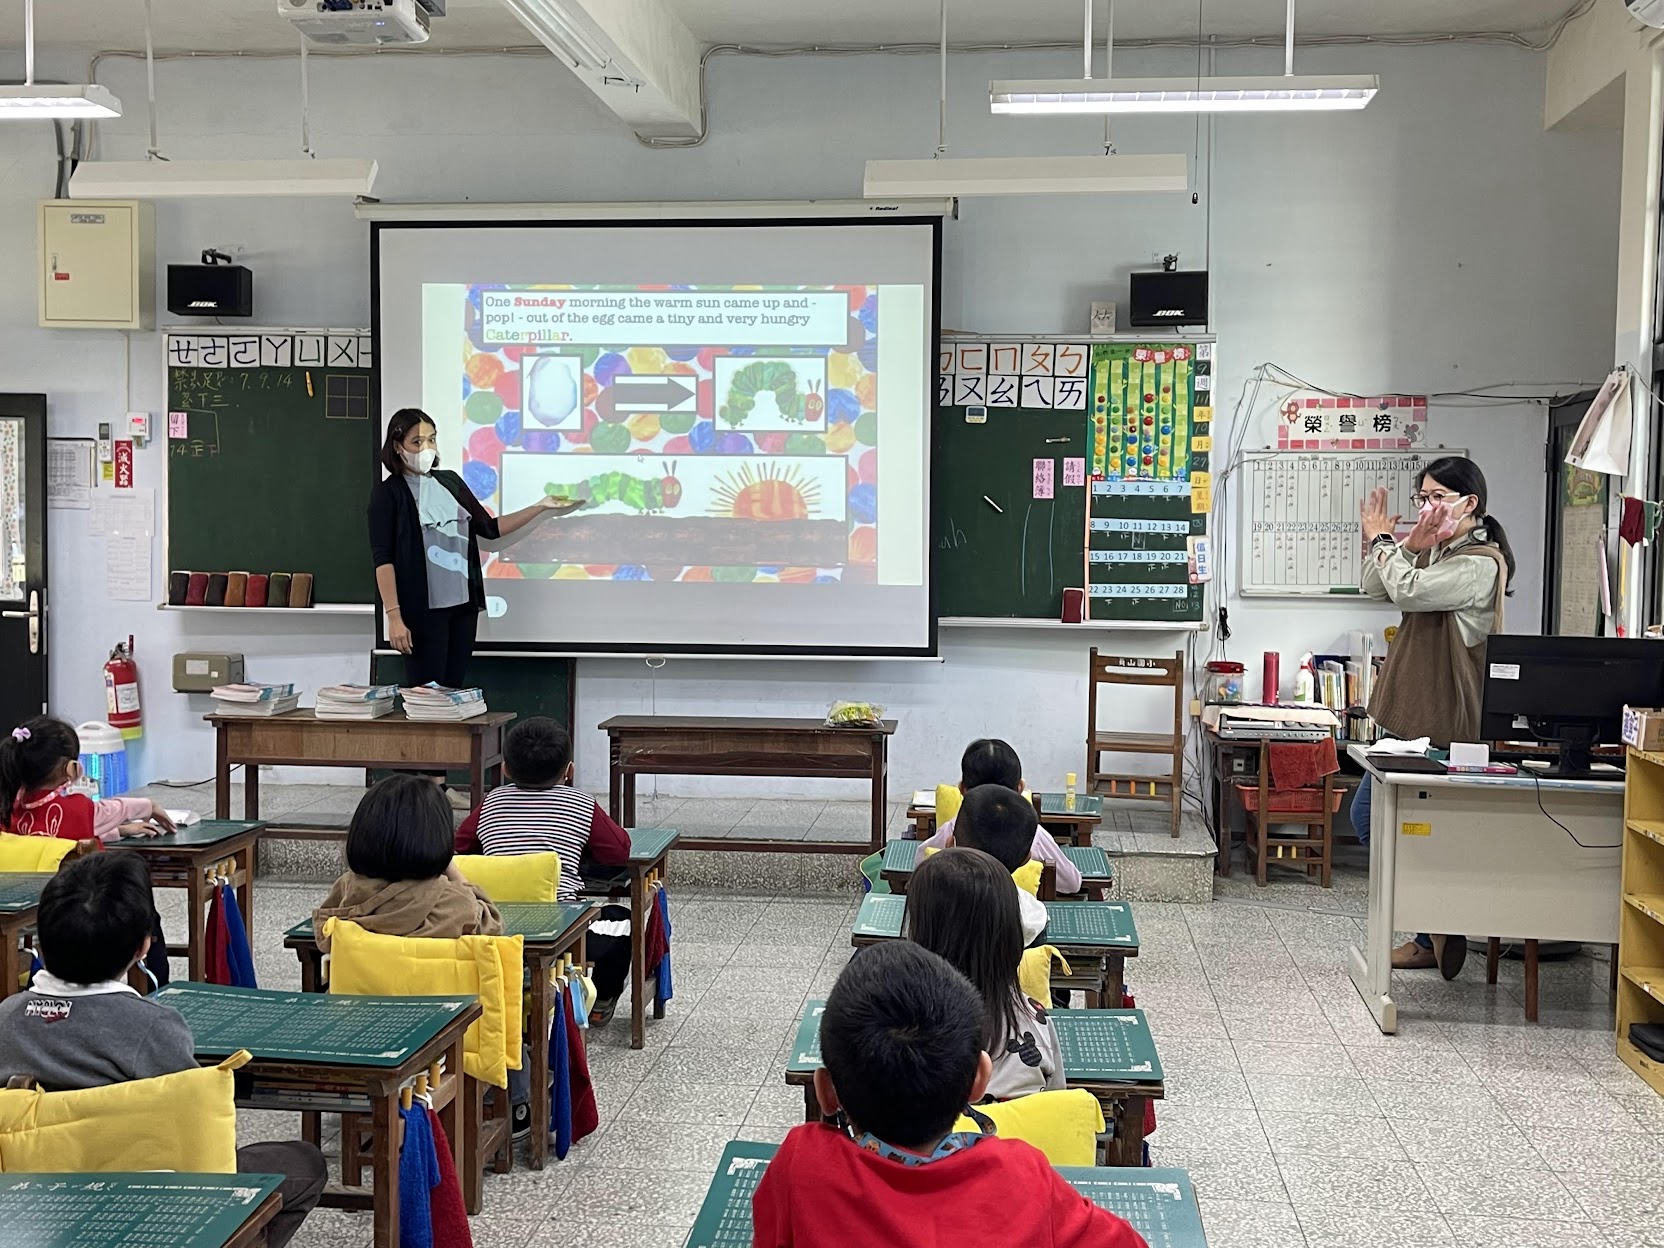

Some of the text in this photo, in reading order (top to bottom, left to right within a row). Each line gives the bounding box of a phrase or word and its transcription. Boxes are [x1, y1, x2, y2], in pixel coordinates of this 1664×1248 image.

[486, 296, 511, 307] One
[515, 296, 567, 309] Sunday
[570, 297, 626, 309] morning
[629, 296, 651, 307] the
[654, 299, 694, 308] warm
[696, 299, 721, 308] sun
[724, 299, 760, 308] came
[763, 299, 781, 310] up
[783, 297, 809, 308] and
[486, 312, 515, 325] pop!
[527, 313, 549, 323] out
[551, 312, 566, 323] of
[567, 312, 589, 323] the
[592, 314, 616, 325] egg
[617, 315, 654, 323] came
[656, 315, 665, 323] a
[667, 313, 696, 326] tiny
[698, 313, 724, 324] and
[726, 315, 758, 326] very
[761, 313, 811, 326] hungry
[487, 329, 573, 343] Caterpillar.
[1197, 363, 1207, 375] 9
[1195, 423, 1208, 435] 10
[1304, 414, 1392, 434] 榮譽榜
[1193, 456, 1206, 466] 27
[1256, 461, 1261, 470] 1
[1268, 461, 1273, 470] 2
[1279, 461, 1284, 470] 3
[1290, 461, 1295, 470] 4
[1301, 461, 1306, 470] 5
[1312, 461, 1317, 470] 6
[1324, 461, 1328, 470] 7
[1334, 461, 1340, 470] 8
[1345, 461, 1351, 470] 9
[1356, 461, 1363, 470] 10
[1367, 461, 1375, 470] 11
[1378, 461, 1387, 470] 12
[1389, 461, 1398, 470] 13
[1401, 461, 1409, 470] 14
[1412, 461, 1420, 470] 15
[1065, 460, 1076, 485] 請假
[1163, 485, 1168, 493] 6
[1178, 485, 1183, 493] 7
[1254, 523, 1262, 532] 19
[1265, 523, 1274, 532] 20
[1276, 523, 1285, 532] 21
[1287, 523, 1296, 532] 22
[1298, 523, 1307, 532] 23
[1309, 523, 1318, 532] 24
[1321, 523, 1329, 532] 25
[1332, 523, 1341, 532] 26
[1343, 523, 1352, 532] 27
[1145, 586, 1155, 594] 26
[1159, 586, 1169, 594] 27
[1173, 586, 1183, 594] 28
